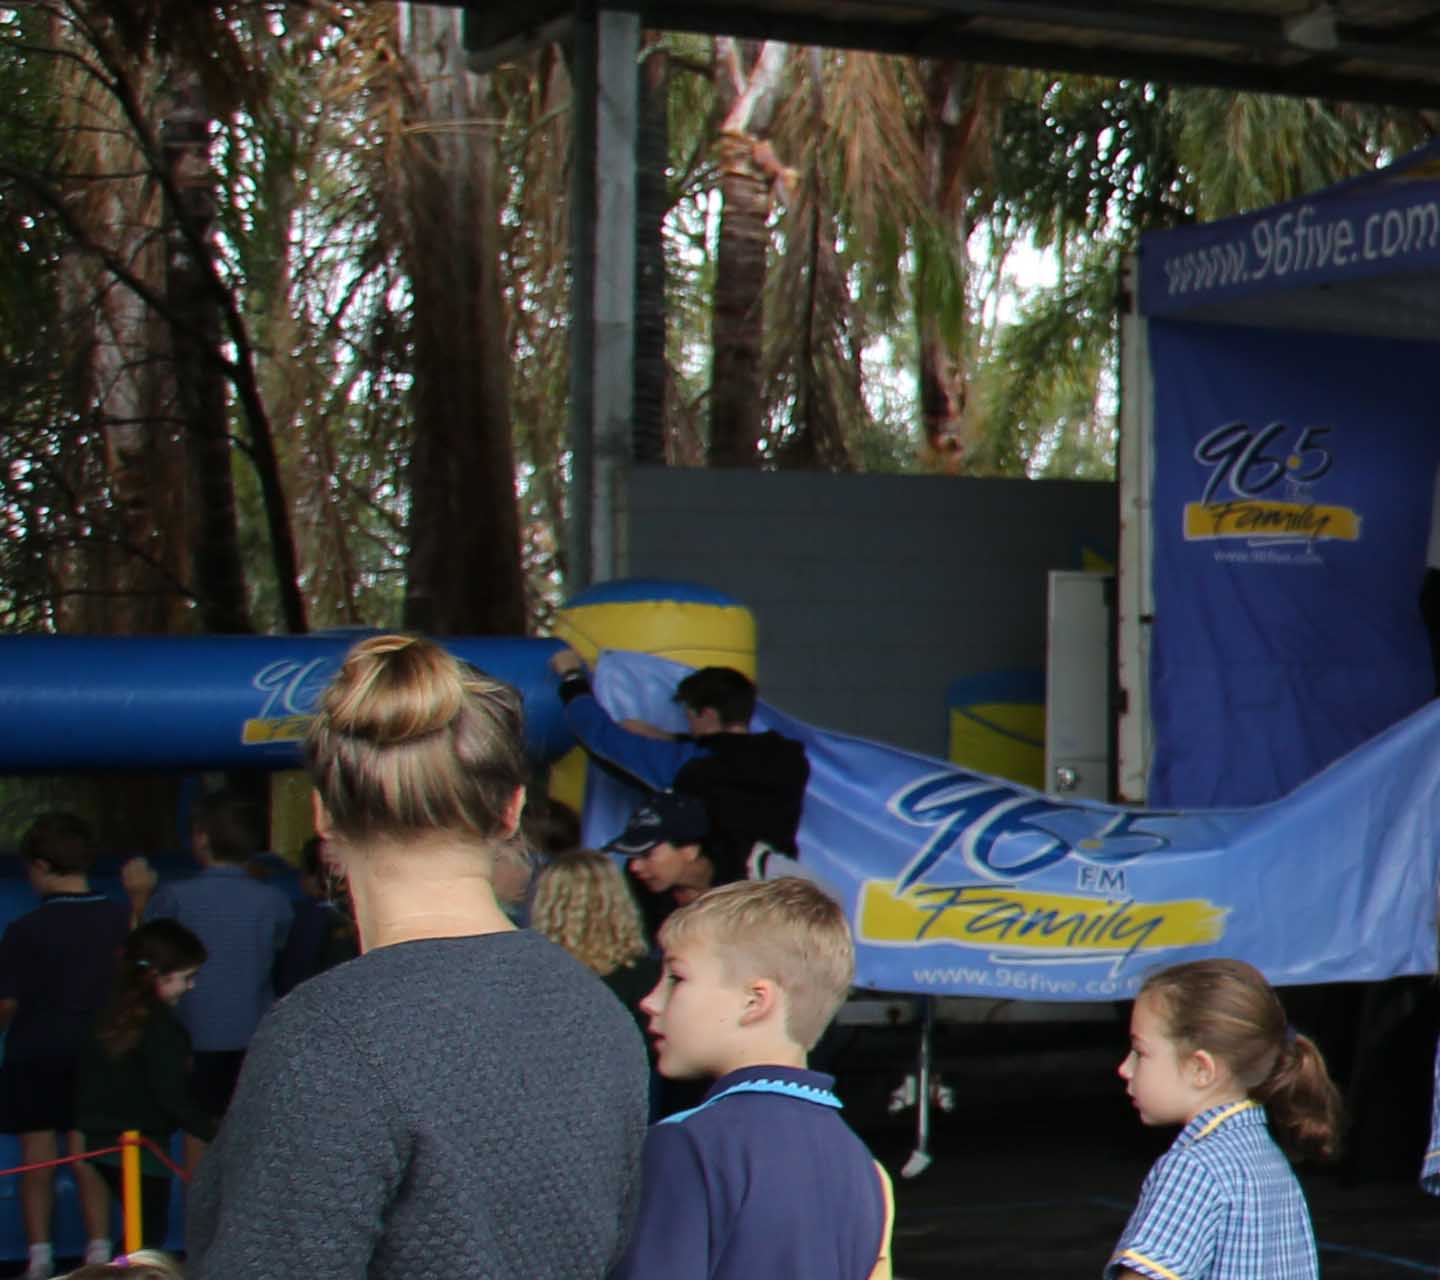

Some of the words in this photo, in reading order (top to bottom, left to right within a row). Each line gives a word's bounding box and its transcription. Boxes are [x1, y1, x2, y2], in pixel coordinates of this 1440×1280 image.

[1165, 202, 1440, 296] www.96five.com
[1078, 865, 1128, 893] FM
[914, 883, 1166, 973] Family
